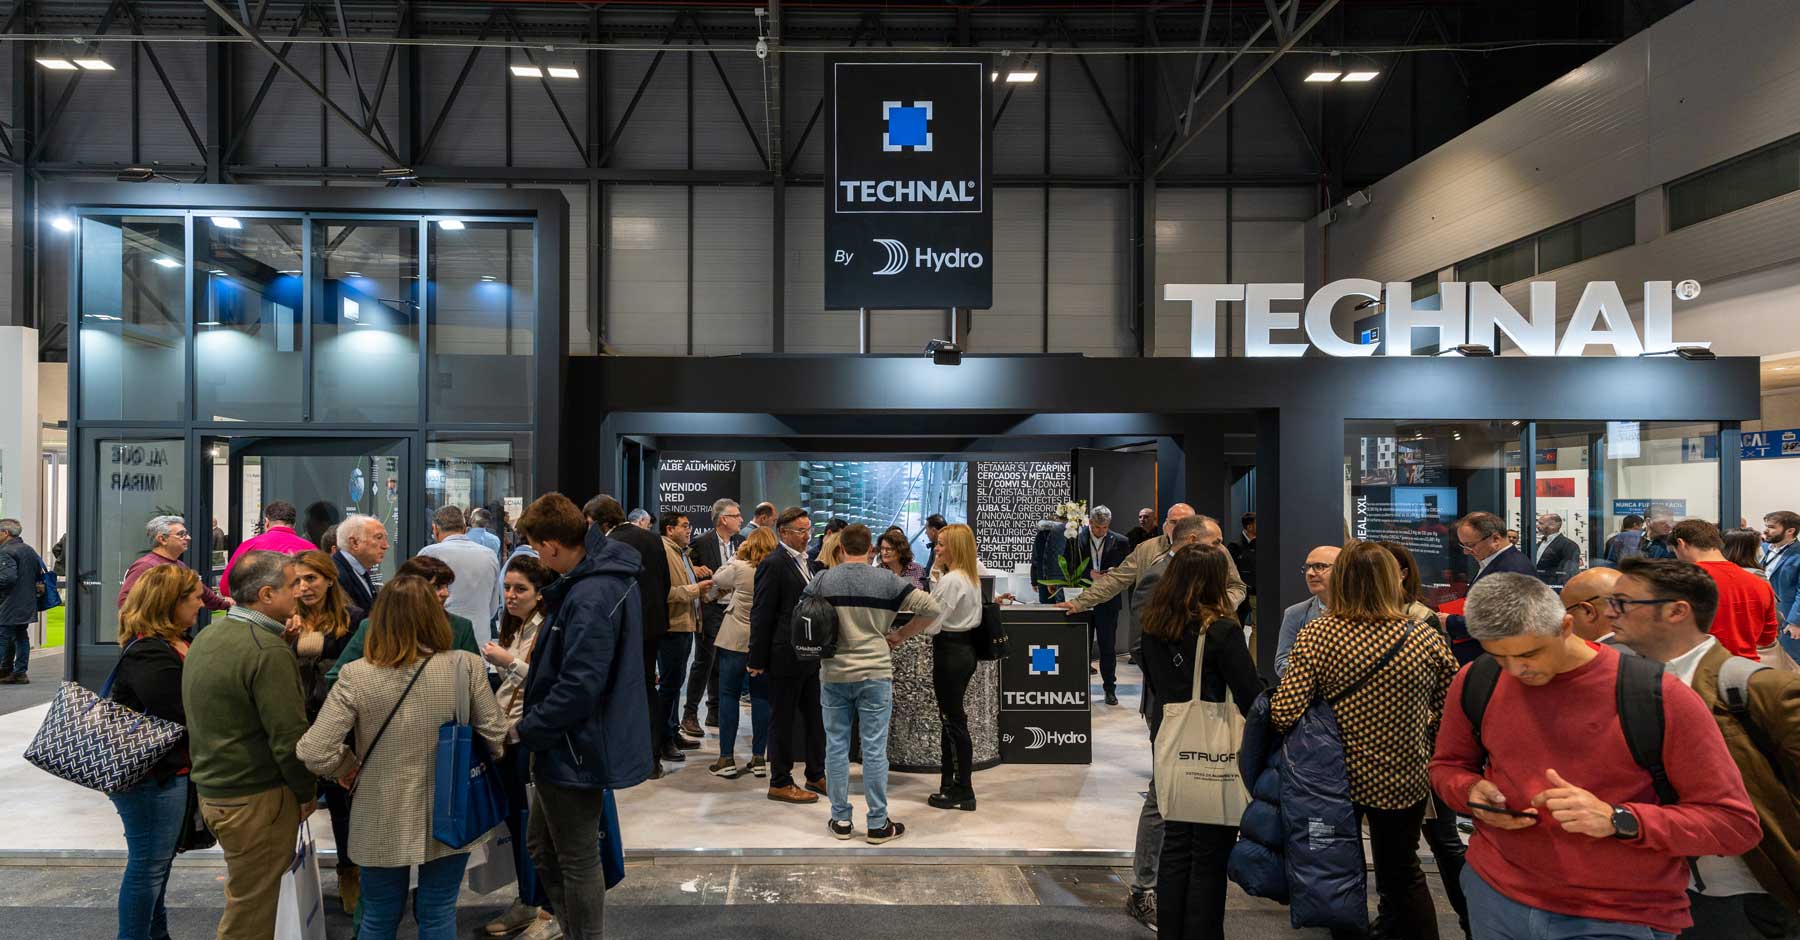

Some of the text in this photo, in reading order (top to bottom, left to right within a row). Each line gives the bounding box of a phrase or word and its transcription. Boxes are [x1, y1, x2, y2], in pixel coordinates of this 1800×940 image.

[834, 248, 984, 272] By Hydro
[685, 464, 730, 472] ALUMINIOS
[977, 464, 1016, 472] RETAMAR
[1018, 464, 1028, 472] SL
[978, 472, 1020, 480] CERCADOS
[1022, 472, 1028, 480] Y
[1029, 472, 1065, 480] METALES
[664, 493, 684, 502] RED
[1357, 495, 1367, 539] EAL XXL
[1002, 730, 1087, 746] By Hydro
